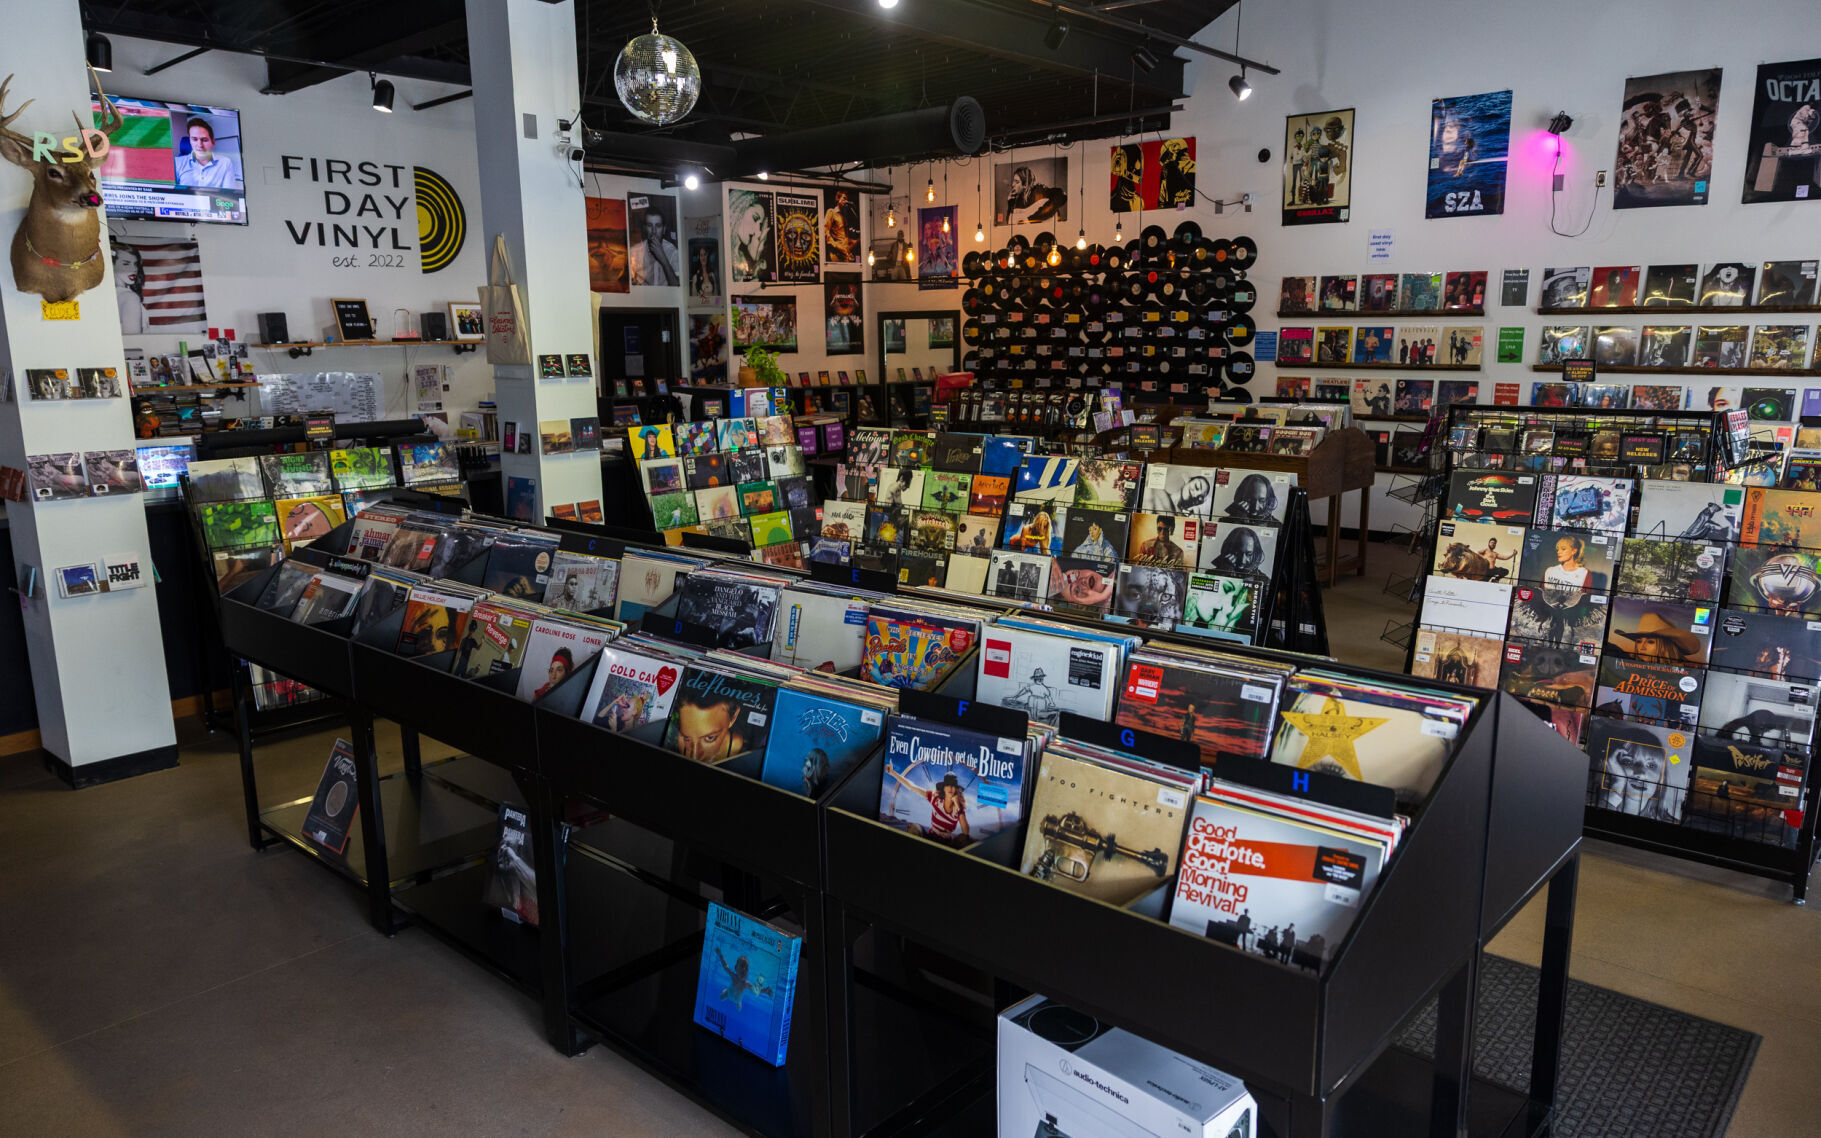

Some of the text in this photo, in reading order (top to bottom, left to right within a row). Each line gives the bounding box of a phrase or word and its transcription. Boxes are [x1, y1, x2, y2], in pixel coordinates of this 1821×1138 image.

[33, 129, 110, 164] RSD
[281, 155, 405, 188] FIRST
[325, 191, 409, 220] DAY
[779, 198, 815, 206] SUBLIME
[1444, 190, 1484, 212] SZA
[285, 220, 412, 251] VINYL
[332, 254, 405, 268] est. 2022
[1729, 412, 1746, 422] NEEDLES
[851, 431, 886, 443] Melvins
[280, 464, 312, 473] LIVING
[364, 512, 396, 522] STEREO
[588, 540, 596, 550] C
[901, 550, 944, 559] FIREHOUSE
[108, 562, 138, 574] TITLE
[109, 570, 140, 583] FIGHT
[852, 569, 860, 583] E
[427, 594, 447, 603] HOLIDAY
[711, 597, 742, 607] VANGUARD
[1250, 590, 1260, 625] NEGATIVE
[473, 610, 497, 623] Breaker's
[712, 609, 737, 618] MESSIAH
[486, 623, 508, 645] Revenge
[535, 626, 602, 646] CAROLINE ROSE LONER
[674, 621, 682, 634] D
[905, 628, 945, 641] BELIEVES
[610, 664, 658, 685] COLD CAV
[1628, 673, 1669, 689] PRICE
[686, 670, 761, 703] deftones
[1613, 680, 1688, 702] ADMISSION
[958, 701, 970, 717] F
[1120, 729, 1135, 748] G
[890, 736, 1014, 779] Even Cowgirls get the Blues
[1728, 745, 1776, 770] Puscifer
[1293, 771, 1309, 793] H
[1050, 776, 1173, 818] FOO FIGHTERS
[504, 808, 526, 828] PANTERA
[1192, 816, 1237, 839] Good
[502, 826, 525, 846] PANTERA
[1185, 849, 1230, 873] Good
[1188, 835, 1266, 869] Charlotte.
[1181, 868, 1248, 902] Morning
[1177, 881, 1239, 916] Revival.
[1073, 1069, 1129, 1104] audio-technica
